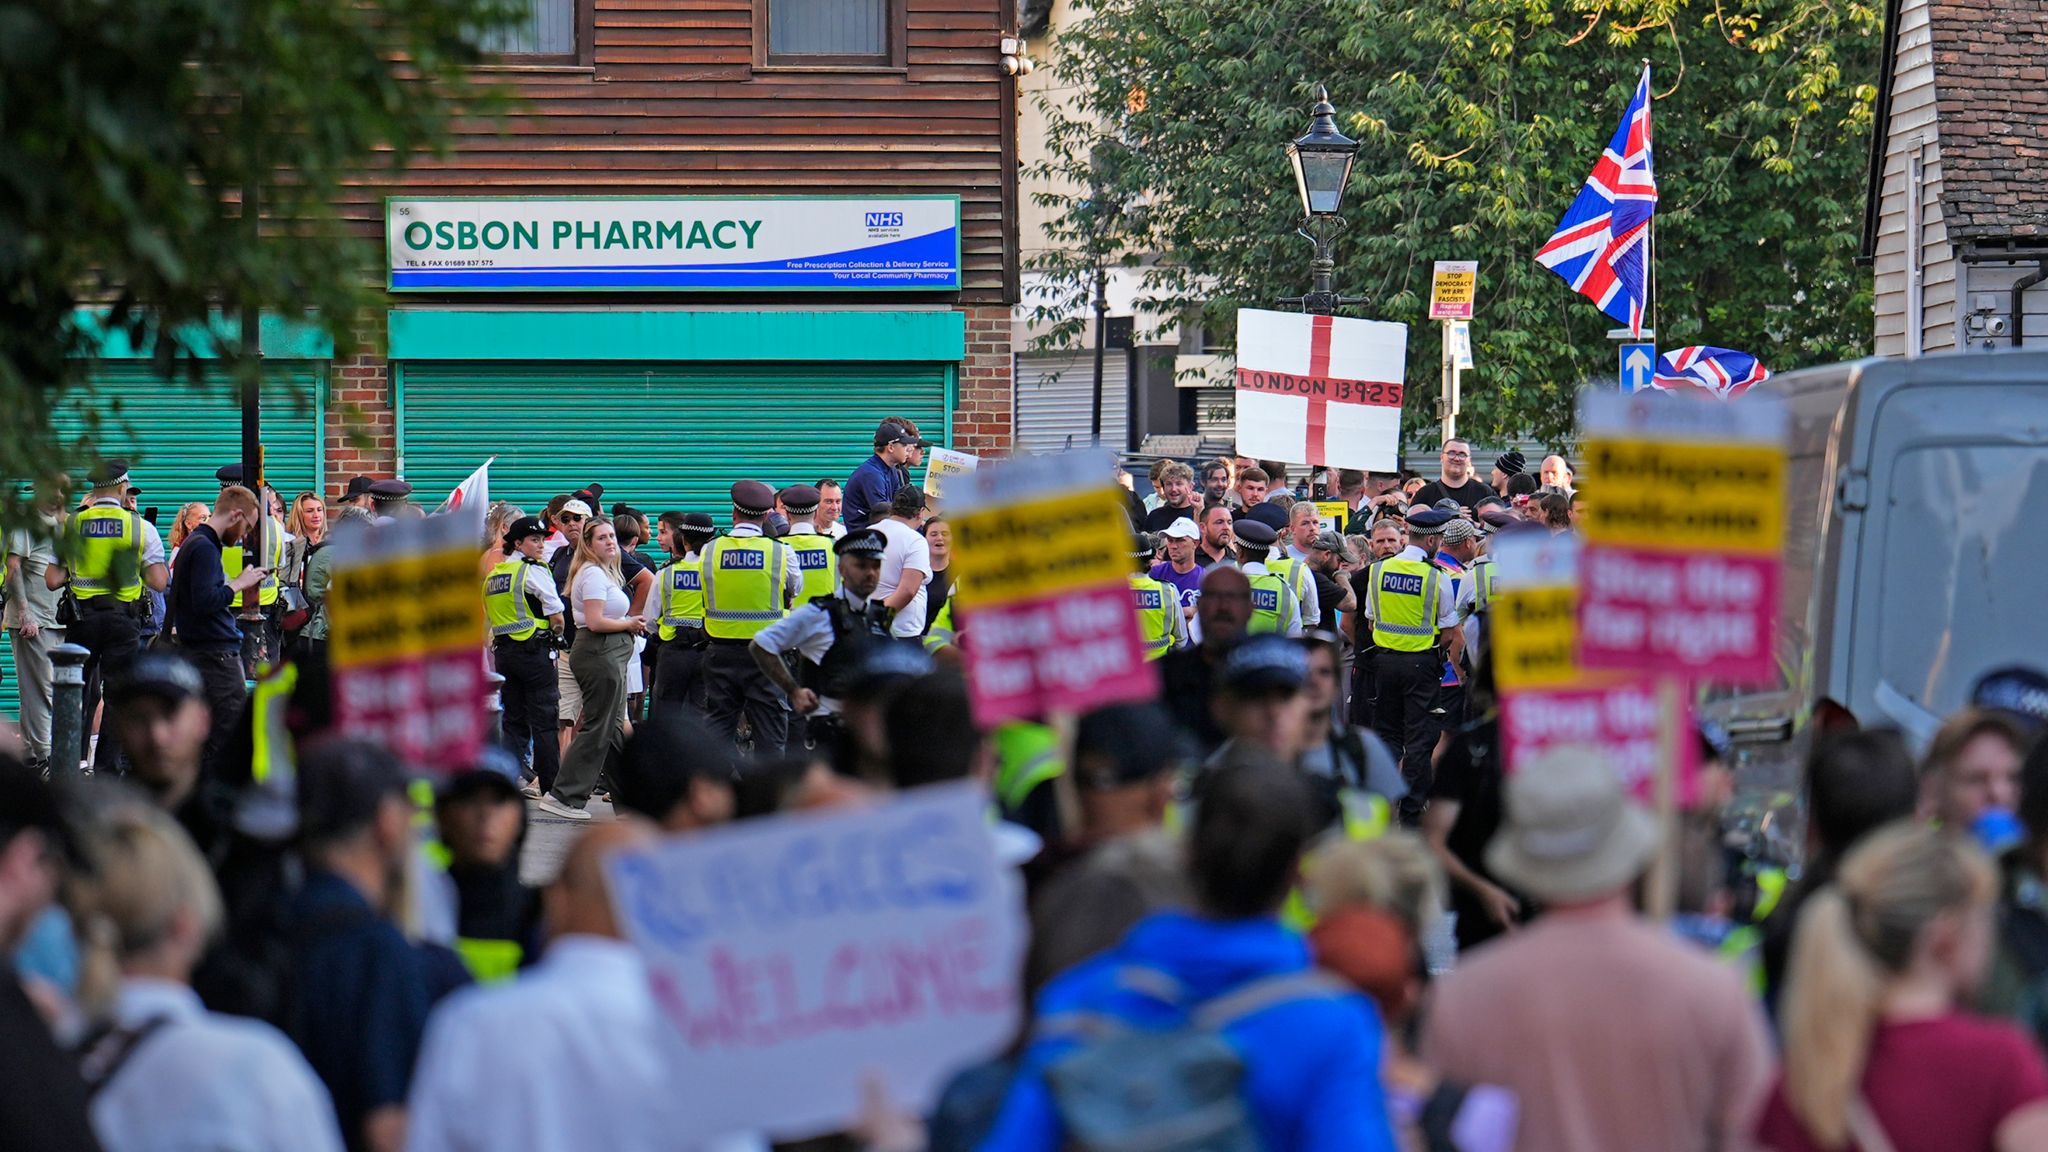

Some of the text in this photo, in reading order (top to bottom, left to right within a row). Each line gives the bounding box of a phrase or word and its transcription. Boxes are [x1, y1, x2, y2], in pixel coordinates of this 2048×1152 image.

[866, 213, 902, 226] NHS
[404, 220, 763, 251] OSBON PHARMACY
[804, 261, 847, 269] Prescription
[892, 261, 921, 269] Delivery
[872, 272, 912, 280] Community
[913, 272, 949, 280] Pharmacy
[1240, 371, 1327, 395] LONDON
[943, 464, 961, 473] STOP
[82, 521, 121, 535] POLICE
[722, 553, 763, 567] POLICE
[675, 573, 700, 587] POLI
[1383, 575, 1421, 592] POLICE
[1135, 592, 1160, 606] LICE
[1251, 591, 1276, 607] LICE
